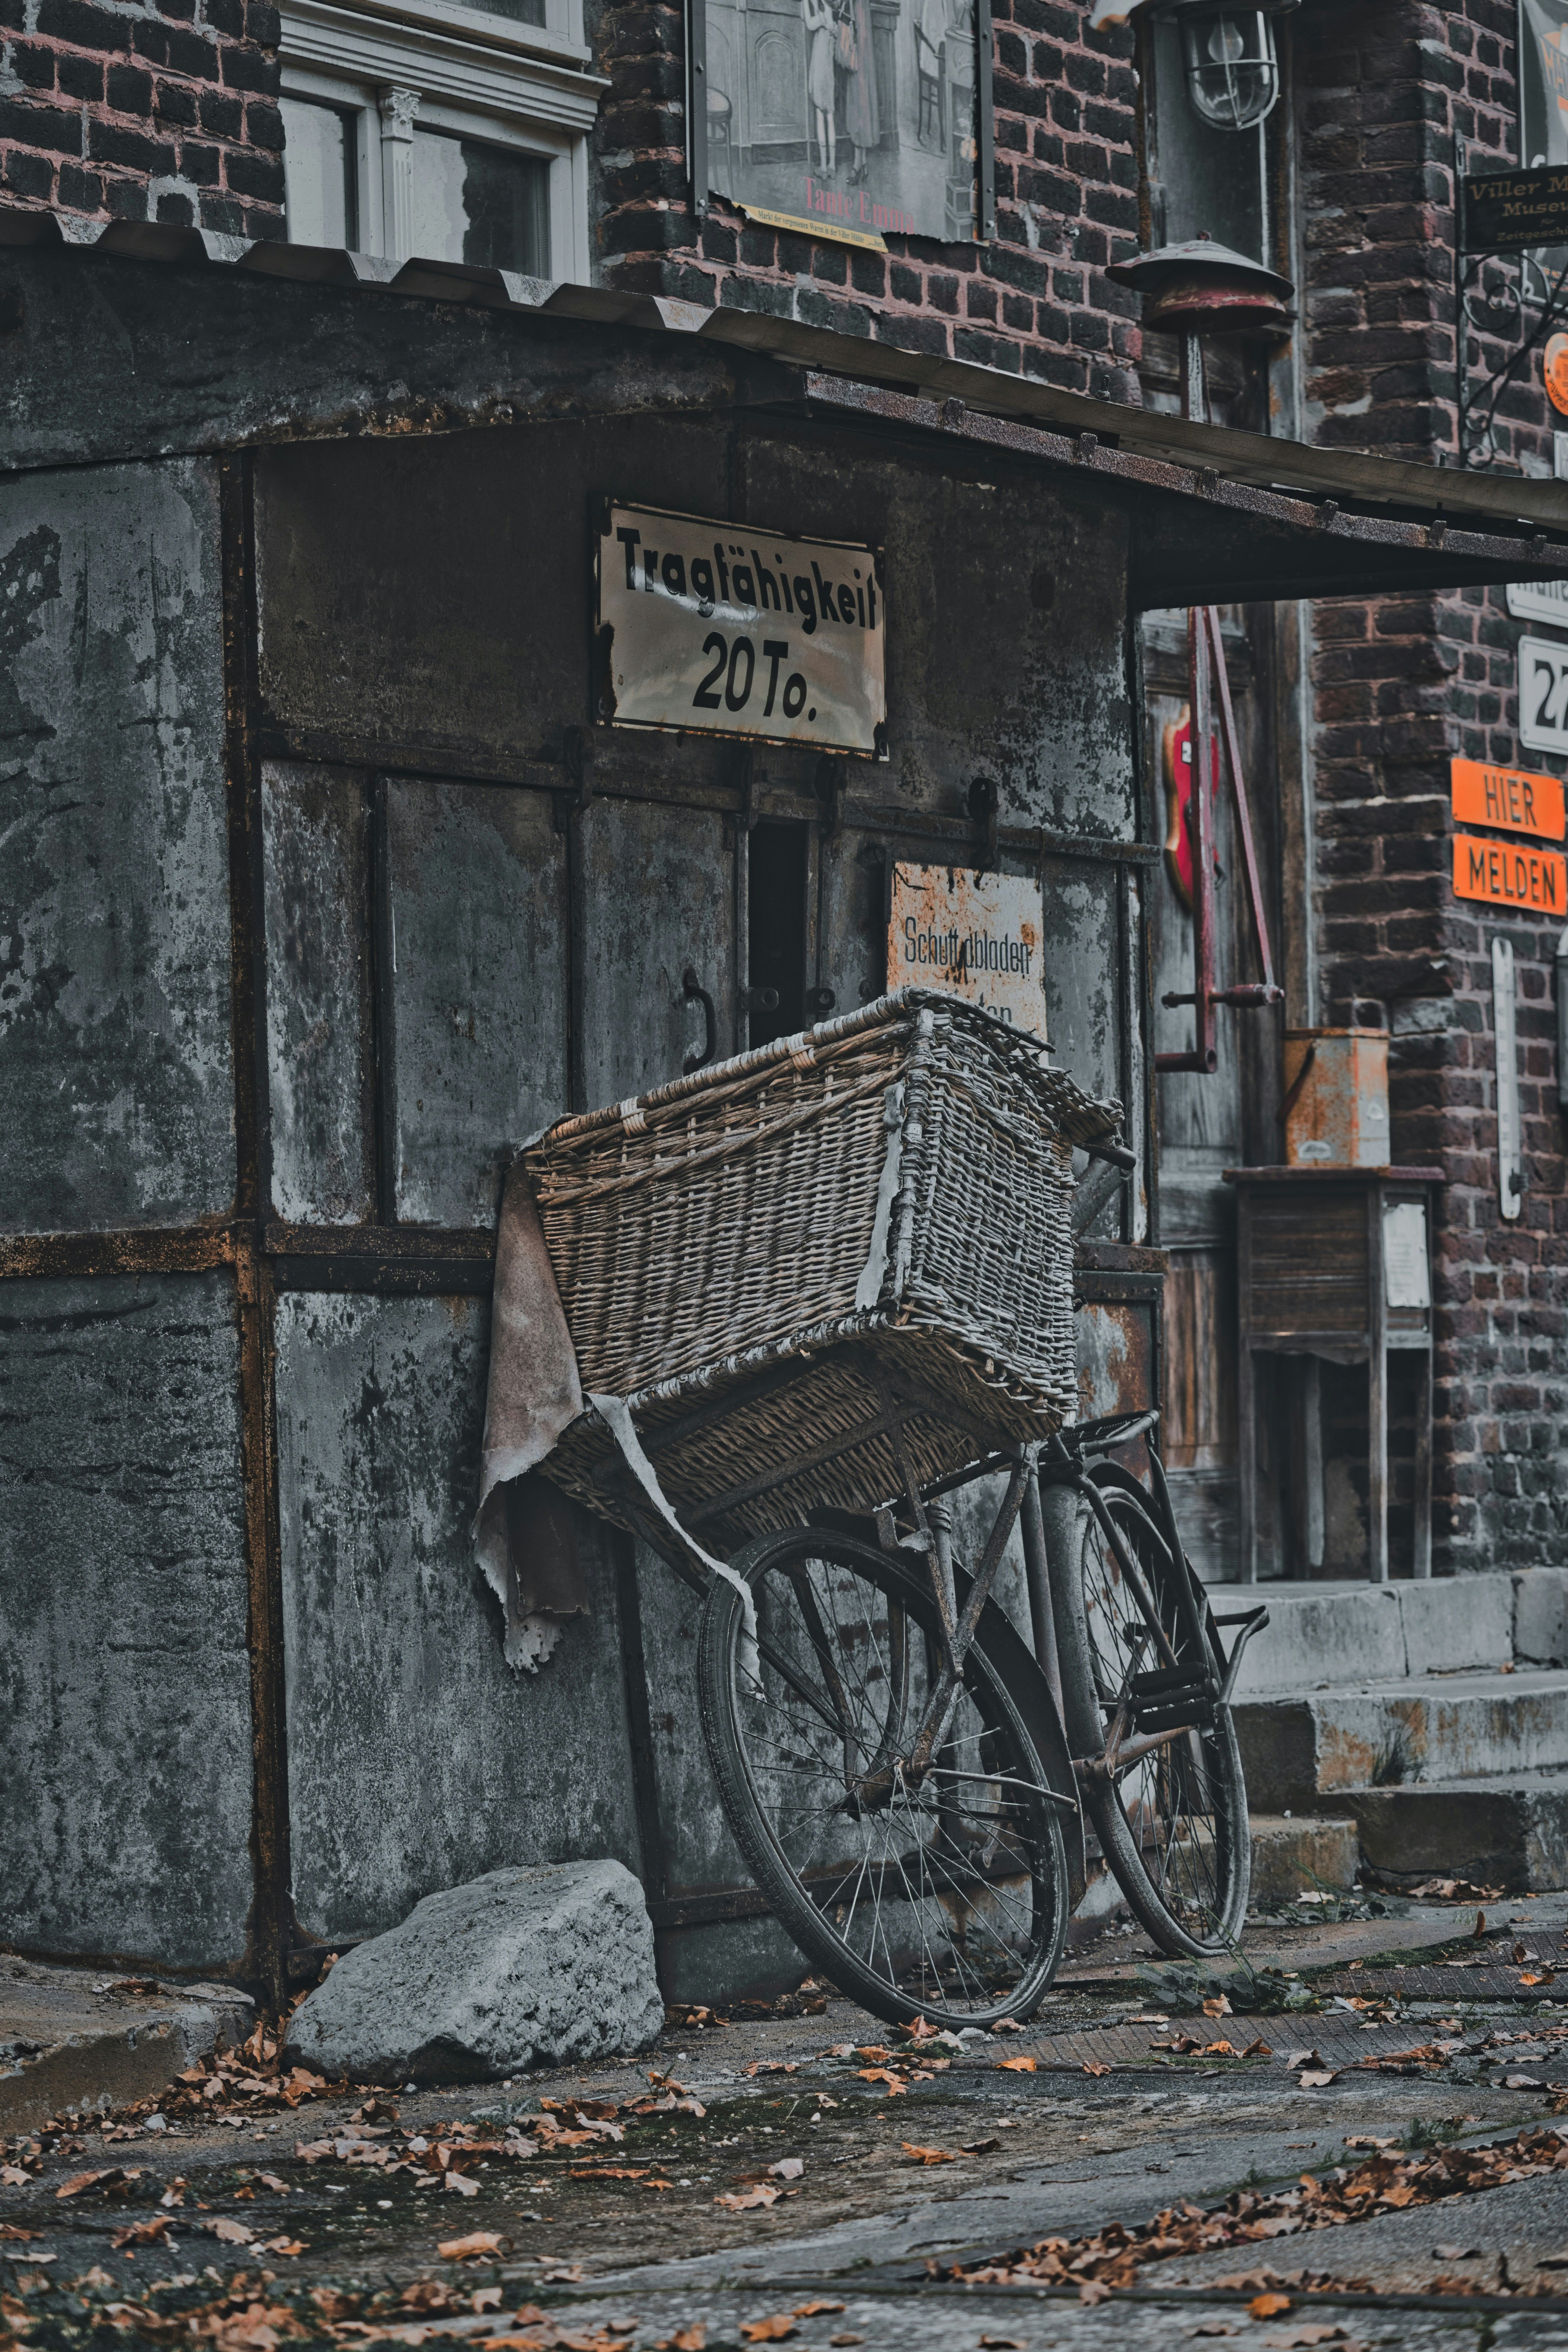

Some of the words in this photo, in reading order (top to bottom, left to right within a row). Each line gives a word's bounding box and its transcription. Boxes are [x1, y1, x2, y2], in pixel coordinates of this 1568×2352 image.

[803, 176, 853, 218] Tante
[858, 191, 915, 234] Emma
[1469, 180, 1542, 200] Viller
[759, 210, 773, 221] Markt
[810, 221, 824, 233] Waren
[825, 226, 829, 234] in
[617, 527, 876, 635] Tragfähigkeit
[692, 631, 755, 712] 20
[763, 639, 817, 722] To.
[1485, 774, 1537, 827] HIER
[1469, 846, 1556, 906] MELDEN
